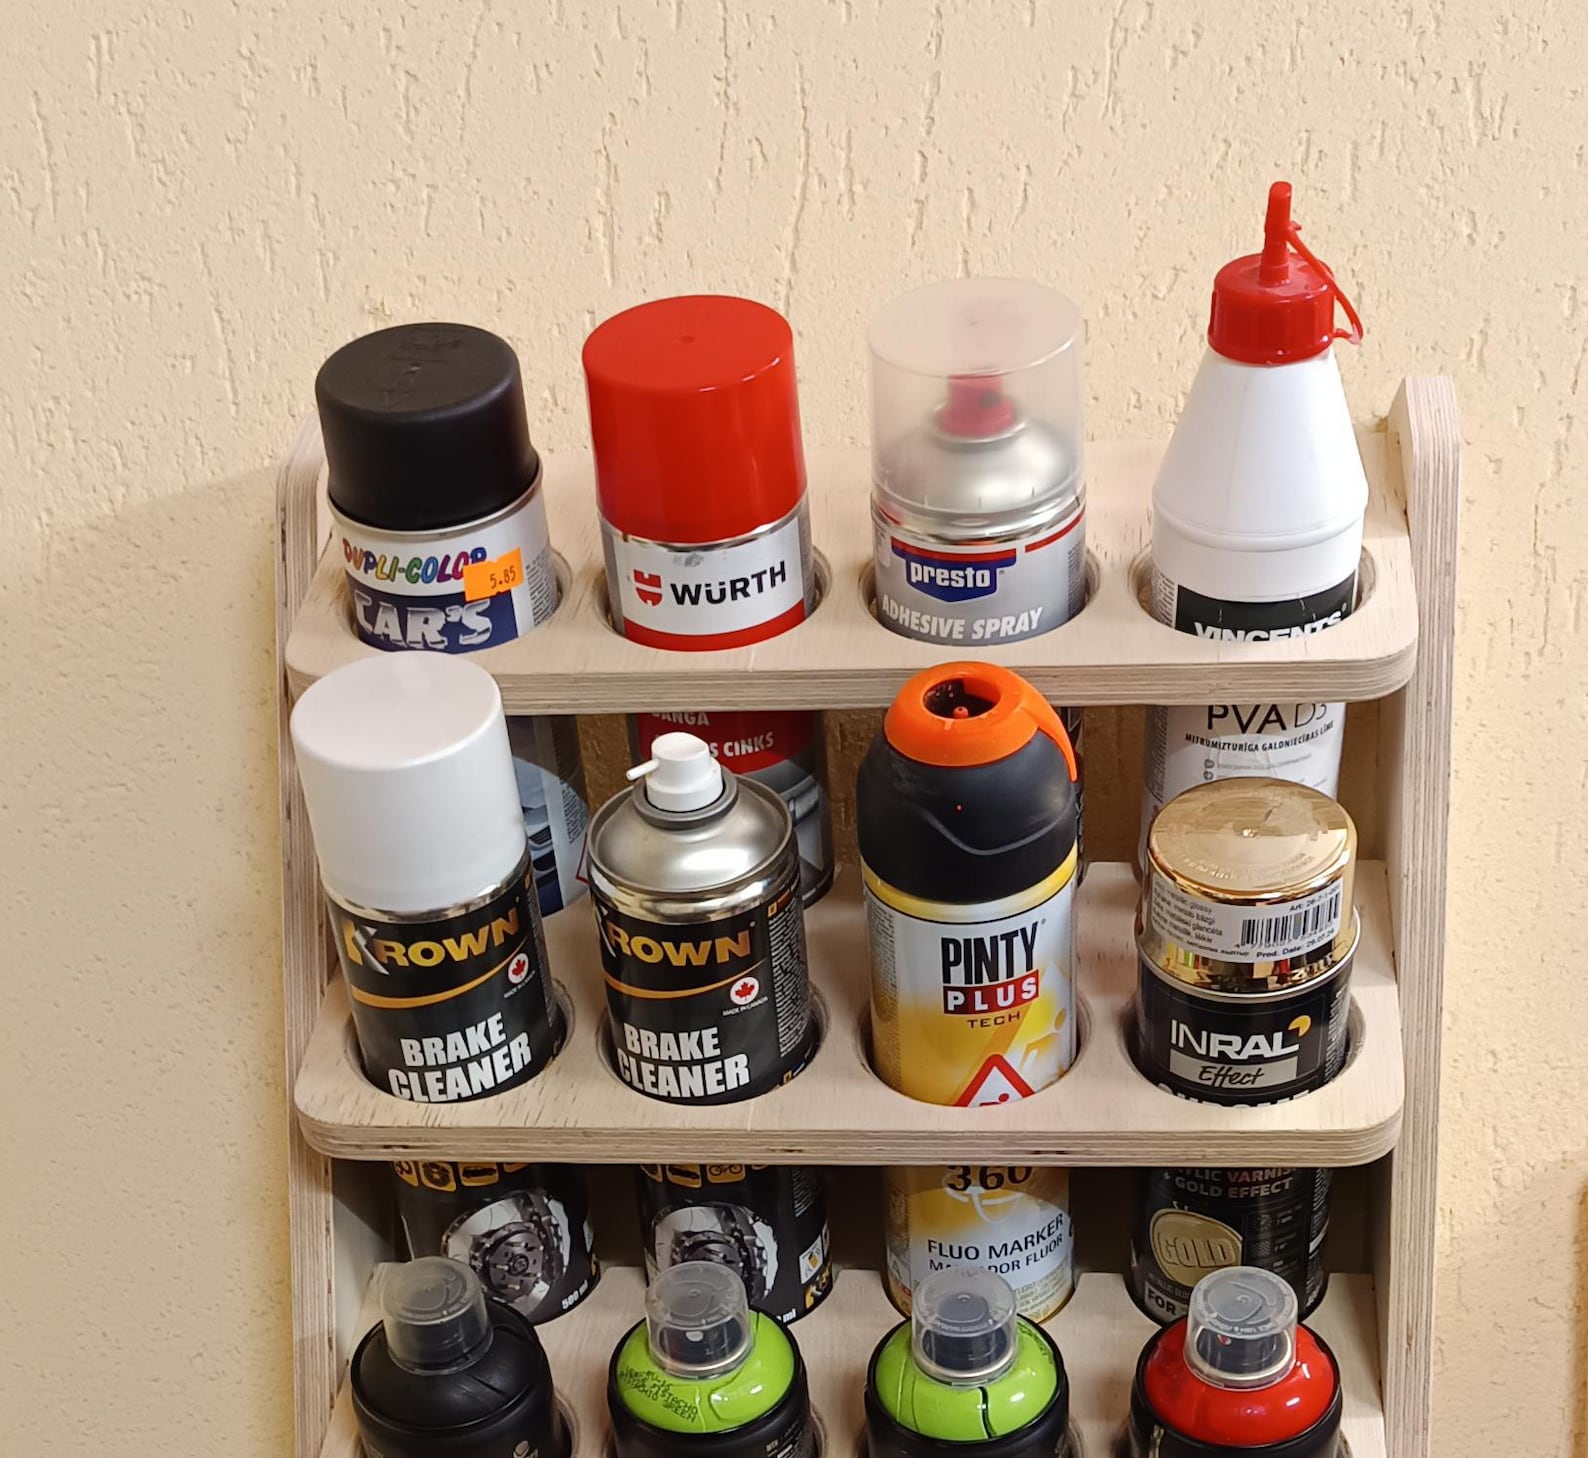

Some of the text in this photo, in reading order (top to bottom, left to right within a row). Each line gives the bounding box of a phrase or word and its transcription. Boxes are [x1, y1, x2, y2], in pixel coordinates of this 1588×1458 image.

[489, 565, 517, 590] 5.85
[670, 560, 786, 606] WÜRTH
[910, 561, 991, 588] presto
[353, 589, 493, 650] CAR'S
[882, 594, 1043, 640] ADHESIVE SPRAY
[651, 711, 710, 726] ANGA
[1207, 704, 1288, 735] PVA
[723, 731, 774, 757] CINKS
[342, 907, 520, 976] KROWN
[603, 915, 751, 967] ROWN
[941, 921, 1039, 985] PINTY
[947, 976, 1037, 1012] PLUS
[967, 1011, 1021, 1028] TECH
[1170, 1018, 1299, 1060] INRAL
[401, 1012, 506, 1068] BRAKE
[623, 1022, 721, 1062] BRAKE
[388, 1032, 532, 1103] CLEANER
[617, 1047, 750, 1098] CLEANER
[1199, 1065, 1264, 1087] Effect
[1175, 1176, 1293, 1199] GOLD EFFECT
[927, 1213, 1064, 1260] FLUO MARKER
[1025, 1232, 1064, 1267] FLUOR
[1157, 1232, 1236, 1269] GOLD
